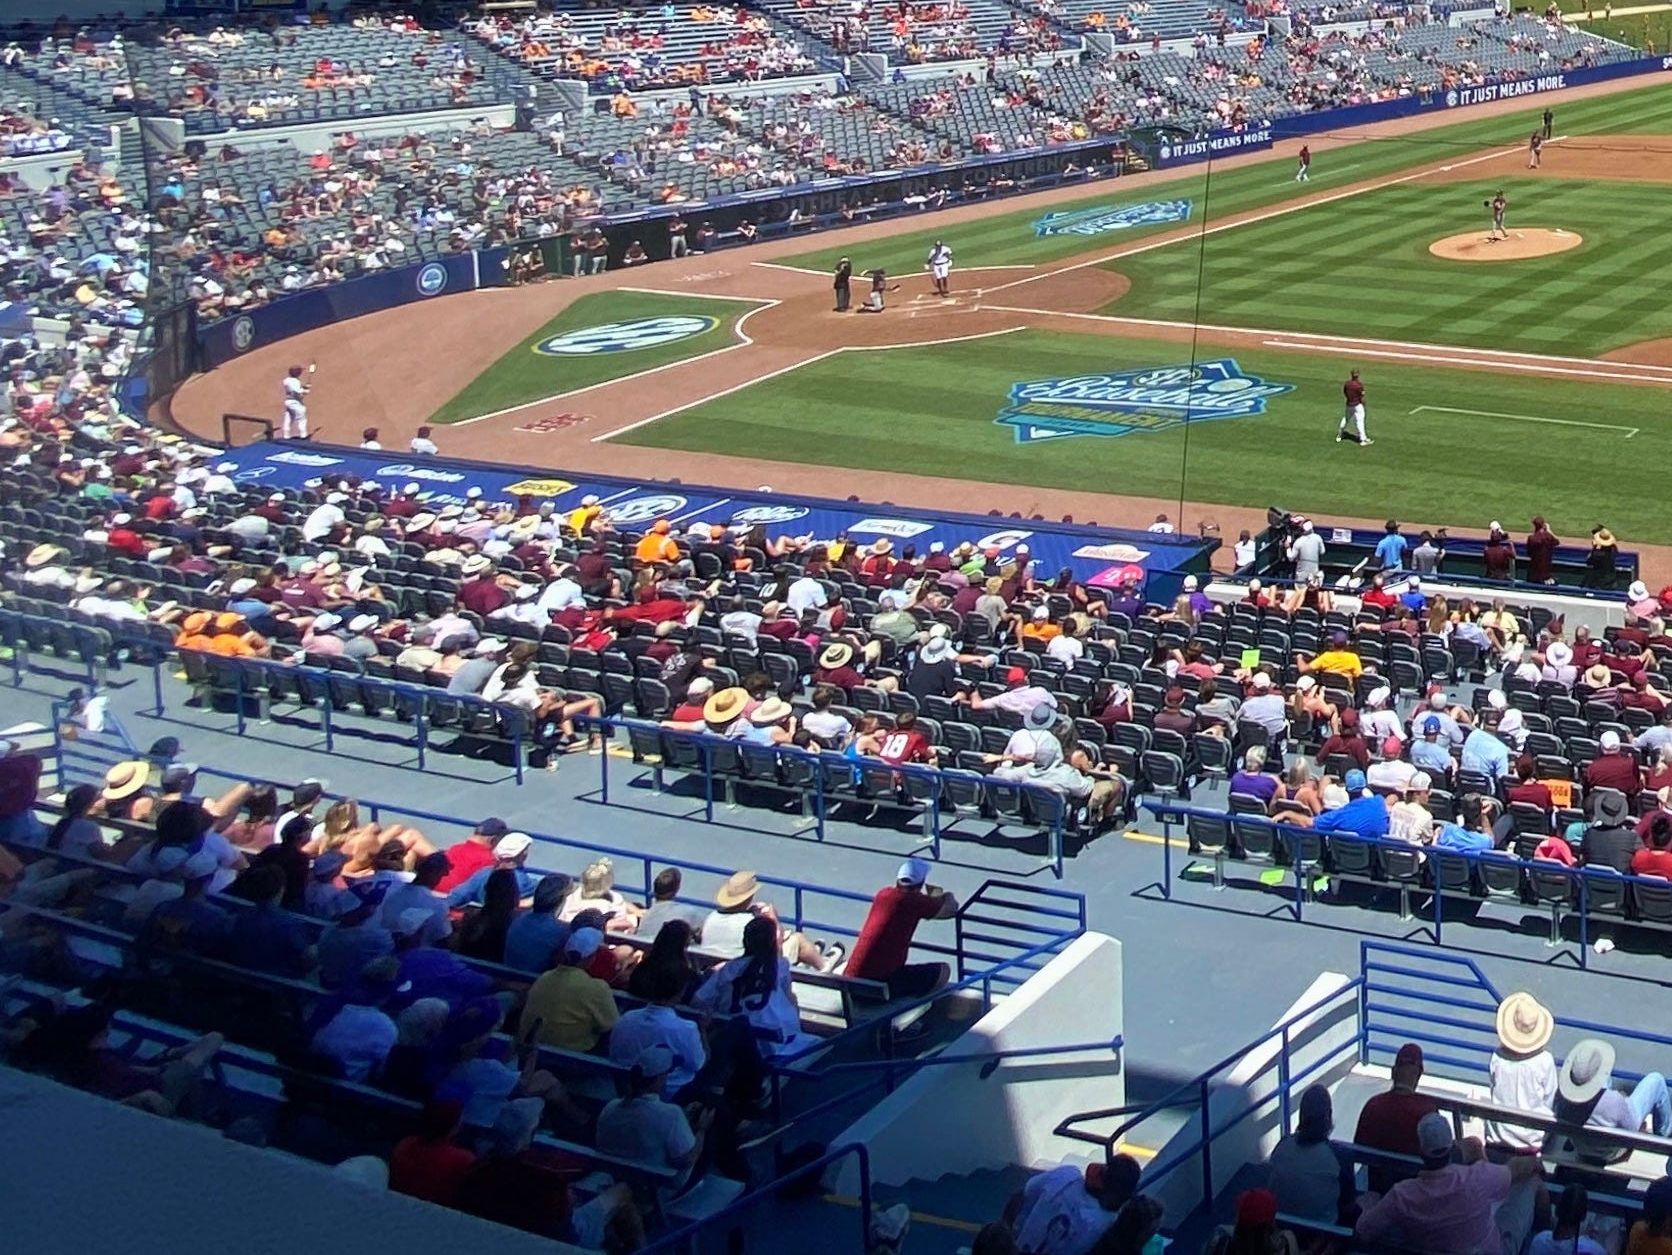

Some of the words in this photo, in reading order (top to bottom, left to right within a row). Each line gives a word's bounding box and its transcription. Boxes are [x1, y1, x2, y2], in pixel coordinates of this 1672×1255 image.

[1460, 90, 1471, 105] IT
[1472, 85, 1498, 104] JUST
[1499, 79, 1536, 98] MEANS
[1173, 145, 1183, 157] IT
[1183, 142, 1208, 155] JUST
[1208, 135, 1242, 150] MEANS
[880, 734, 909, 759] 18
